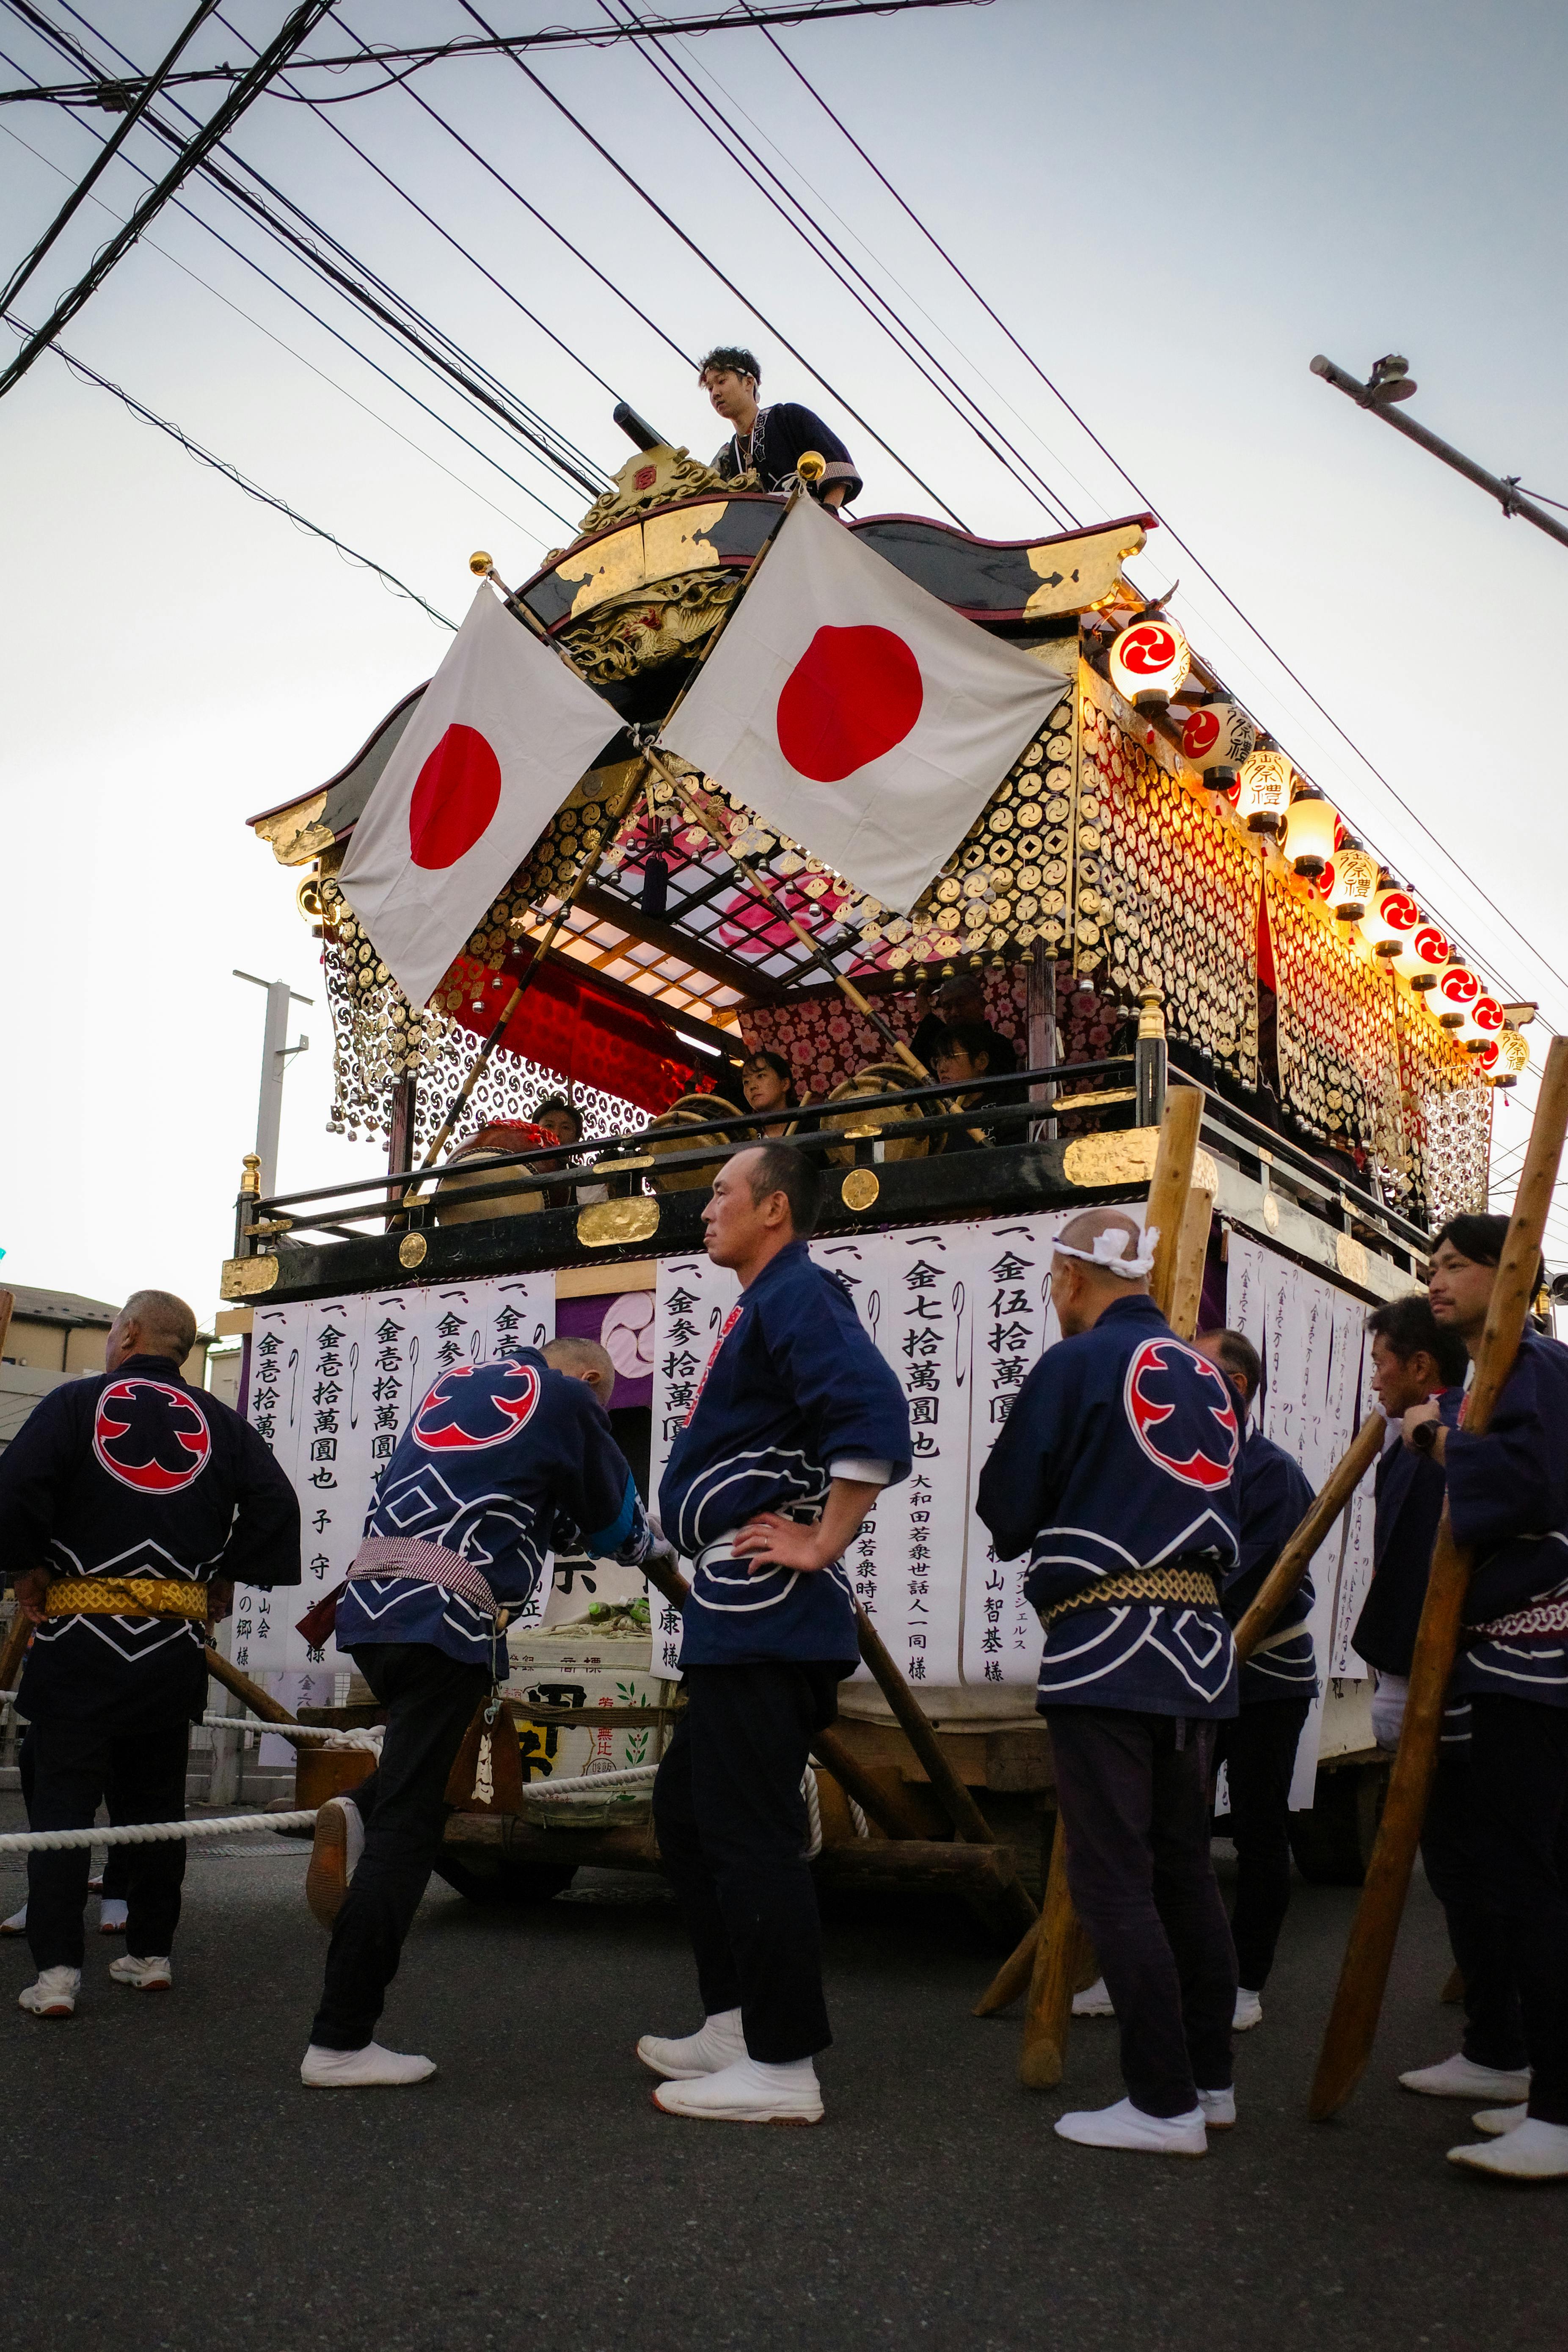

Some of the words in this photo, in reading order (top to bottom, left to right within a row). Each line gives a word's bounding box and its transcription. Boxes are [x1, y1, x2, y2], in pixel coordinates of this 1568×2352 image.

[253, 1312, 287, 1454] 一、金壱拾萬
[660, 1264, 702, 1464] 一、金参拾萬圓
[987, 1226, 1036, 1449] 一、金伍拾萬圓
[236, 1584, 252, 1666] の郷様
[306, 1510, 333, 1663] 子守様
